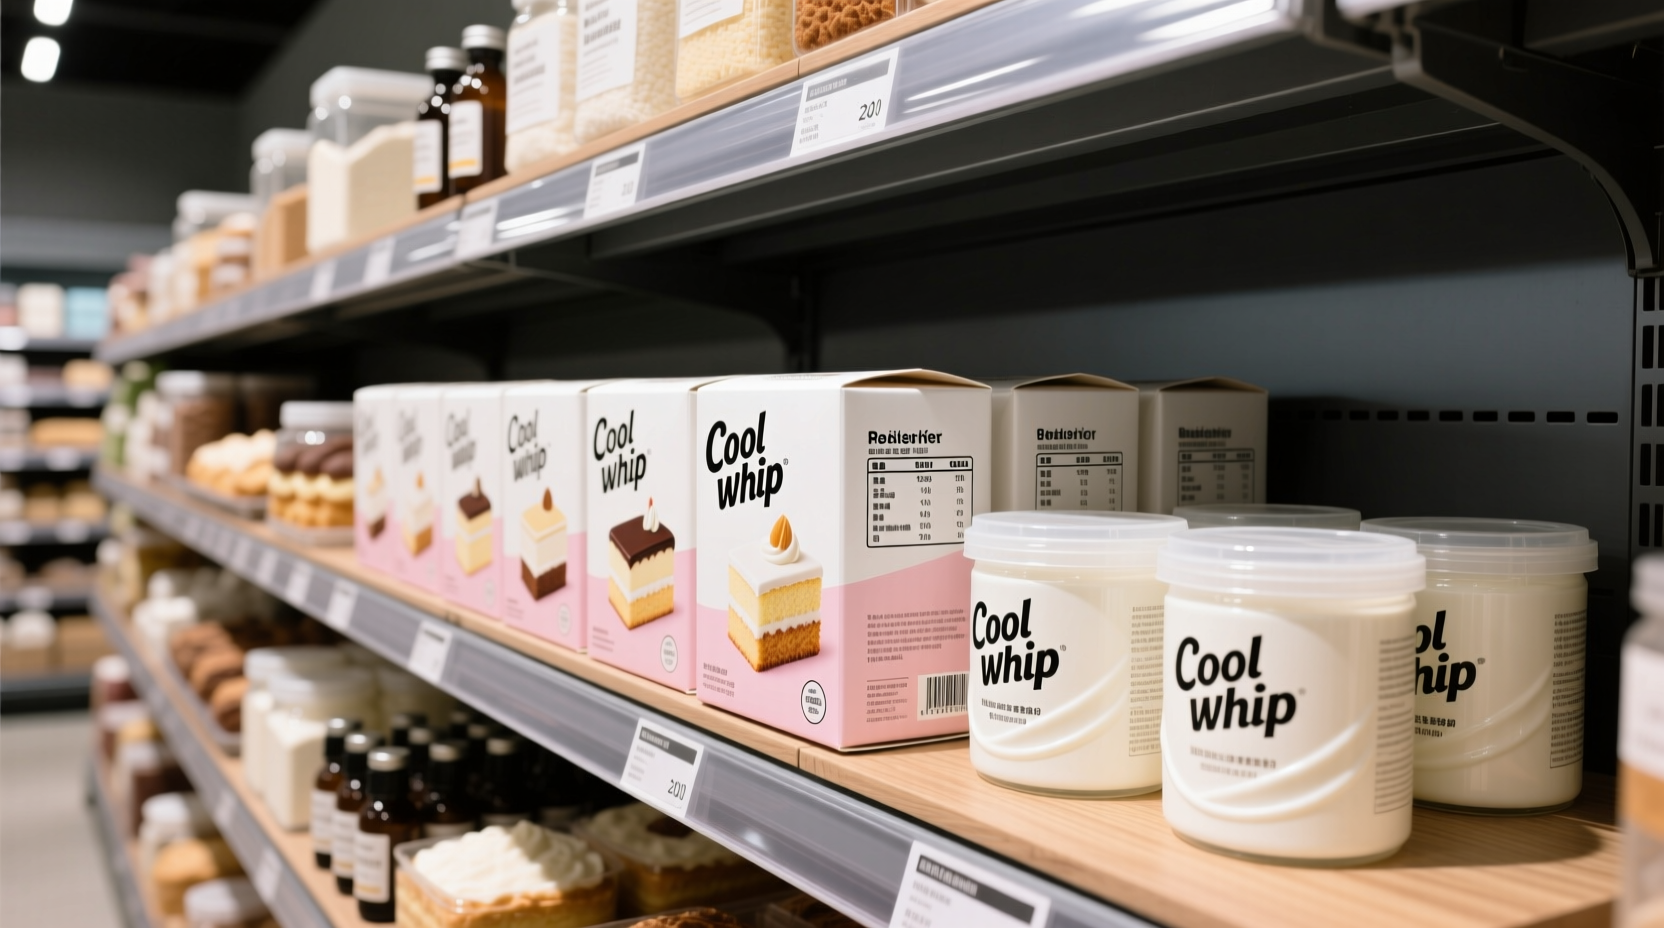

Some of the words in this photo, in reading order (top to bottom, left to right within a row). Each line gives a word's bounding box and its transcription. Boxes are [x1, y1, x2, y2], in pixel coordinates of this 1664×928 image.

[858, 98, 882, 122] 200
[507, 409, 539, 454] Cool
[593, 409, 635, 462] Cool
[705, 410, 767, 474] Cool
[601, 447, 647, 493] whip
[717, 456, 784, 510] whip
[972, 598, 1032, 650] Cool
[1415, 610, 1447, 656] ol
[981, 641, 1060, 691] whip
[1175, 635, 1262, 691] Cool
[1415, 652, 1477, 703] hip
[1190, 683, 1297, 738] whip
[667, 777, 687, 801] 200
